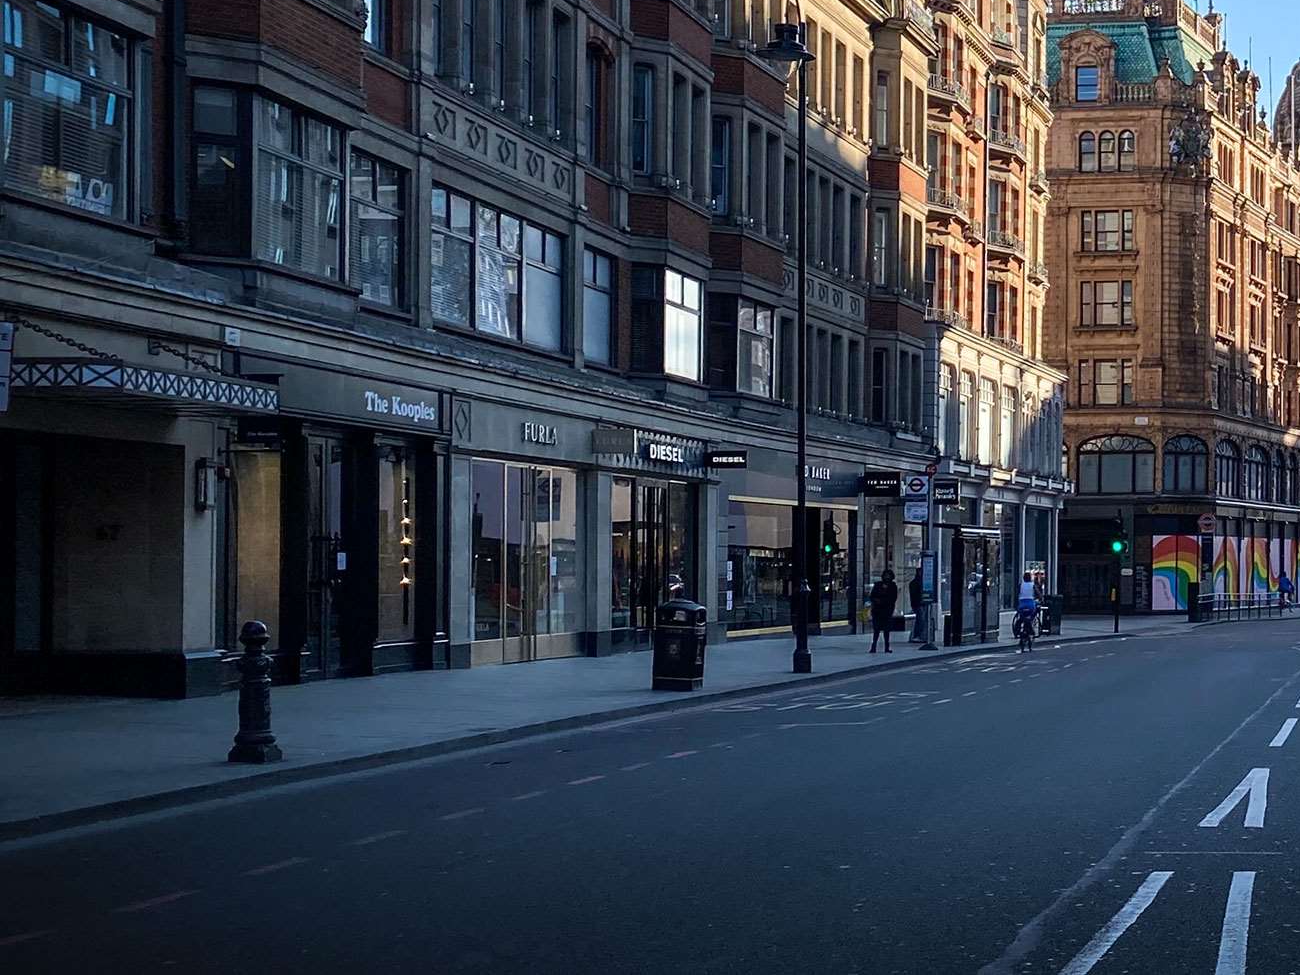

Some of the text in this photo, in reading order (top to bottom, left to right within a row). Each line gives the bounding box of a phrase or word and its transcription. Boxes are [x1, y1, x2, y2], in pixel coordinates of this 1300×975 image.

[365, 391, 435, 422] The Kooples
[524, 422, 558, 445] FURLA
[649, 443, 684, 463] DIESEL
